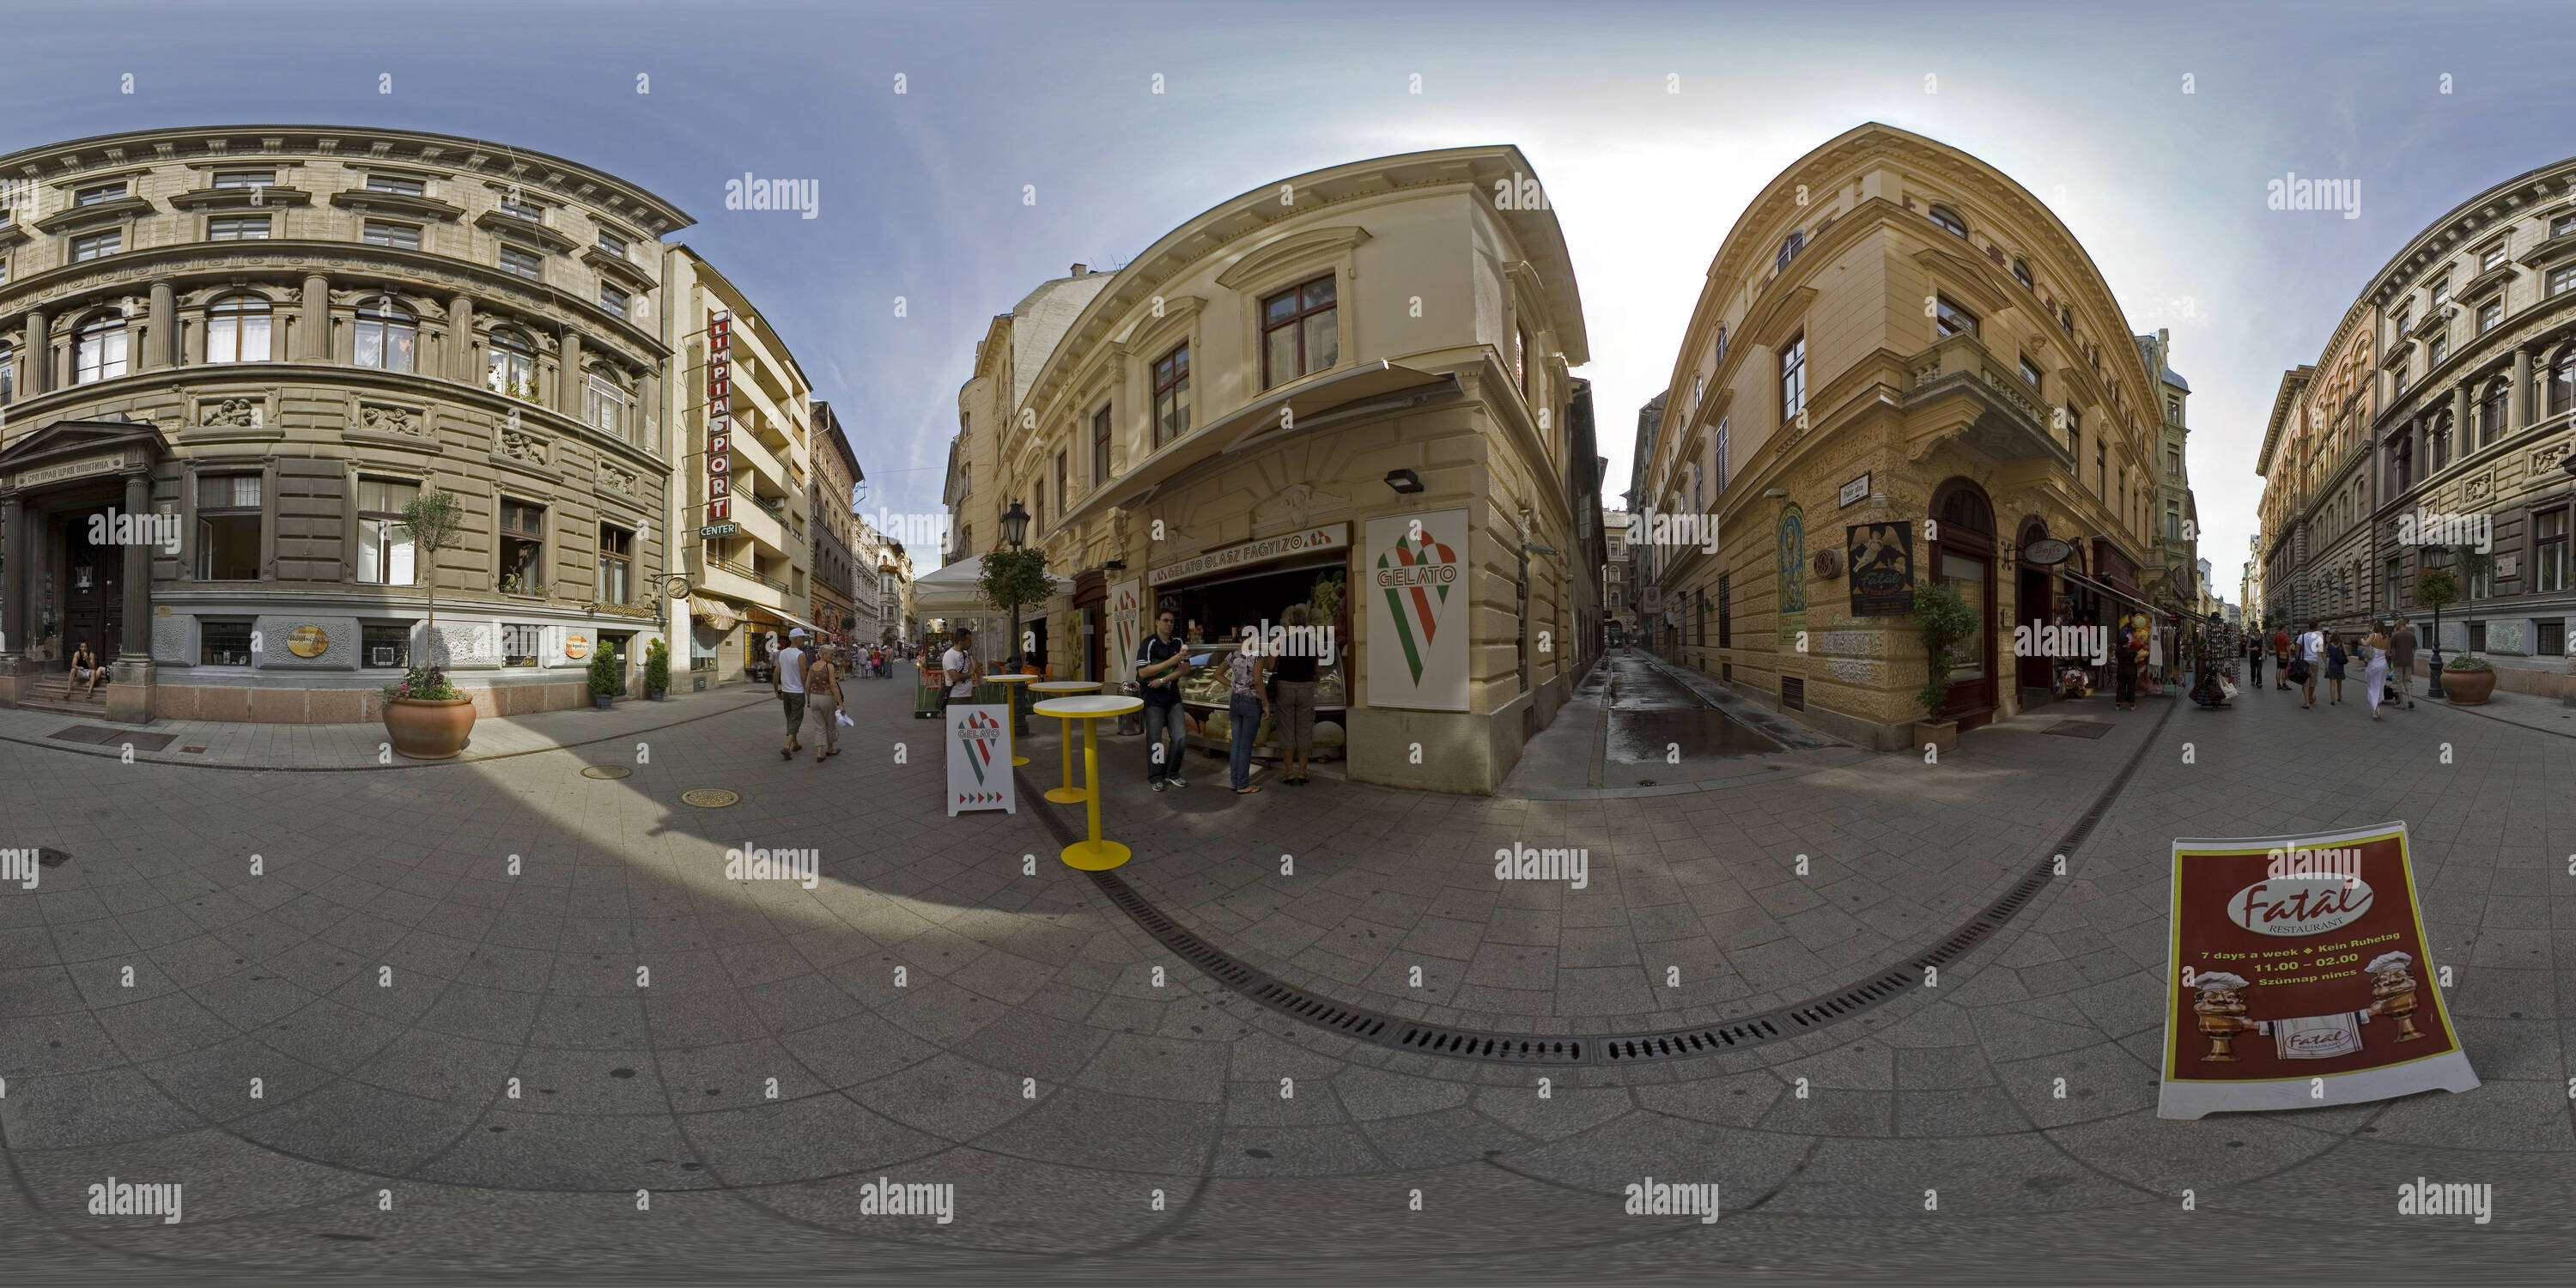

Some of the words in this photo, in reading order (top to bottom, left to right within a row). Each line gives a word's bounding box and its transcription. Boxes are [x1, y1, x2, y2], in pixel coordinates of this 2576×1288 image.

[76, 460, 109, 473] ОПШТИНА
[701, 524, 735, 536] CENTER
[1167, 560, 1203, 579] GELATO
[1204, 550, 1240, 568] OLASZ
[1376, 565, 1457, 587] GELATO
[1115, 609, 1137, 622] GELATO
[958, 728, 1000, 739] GELATO
[2269, 916, 2342, 934] RESTAURANT
[2263, 949, 2299, 958] week
[2318, 942, 2348, 953] Kein
[2350, 933, 2401, 948] Ruhetag
[2254, 962, 2299, 973] 11.00
[2316, 953, 2359, 967] 02.00
[2258, 975, 2318, 986] Szünnap
[2321, 969, 2357, 981] nincs
